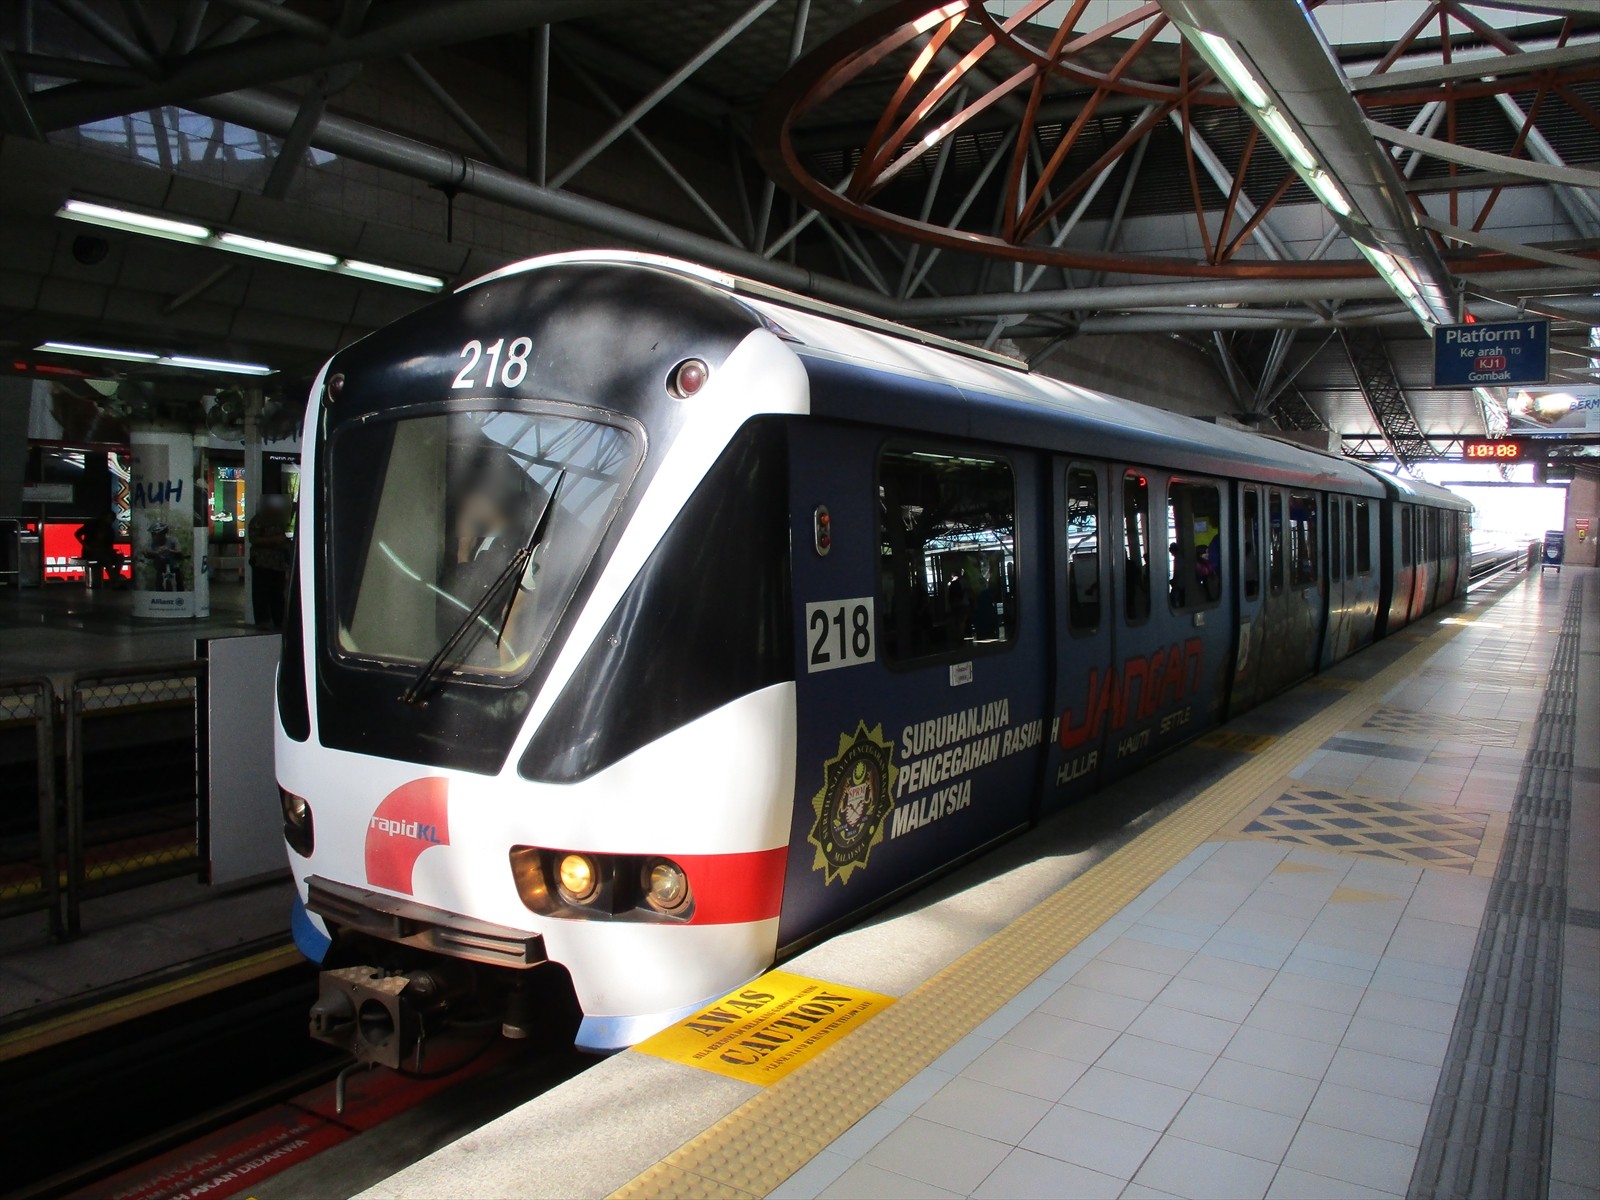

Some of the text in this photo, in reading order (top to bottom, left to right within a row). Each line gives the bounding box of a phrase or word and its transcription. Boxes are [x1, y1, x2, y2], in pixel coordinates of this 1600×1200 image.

[1446, 325, 1537, 344] Platform 1
[1460, 346, 1521, 358] Ke arah TO
[451, 336, 533, 388] 218
[1468, 371, 1511, 382] Gombak
[1479, 358, 1500, 370] KJ1
[1467, 444, 1518, 457] 10:08
[810, 604, 871, 666] 218
[901, 698, 1009, 760] SURUHANJAYA
[897, 717, 1060, 798] PENCEGAHAN RASUAH
[1056, 750, 1098, 787] HULUR
[370, 815, 441, 844] rapidKL
[891, 779, 971, 840] MALAYSIA
[684, 989, 775, 1038] AWAS
[719, 991, 852, 1066] CAUTION
[189, 1171, 238, 1197] AKAN
[238, 1138, 310, 1175] DIDAKWA
